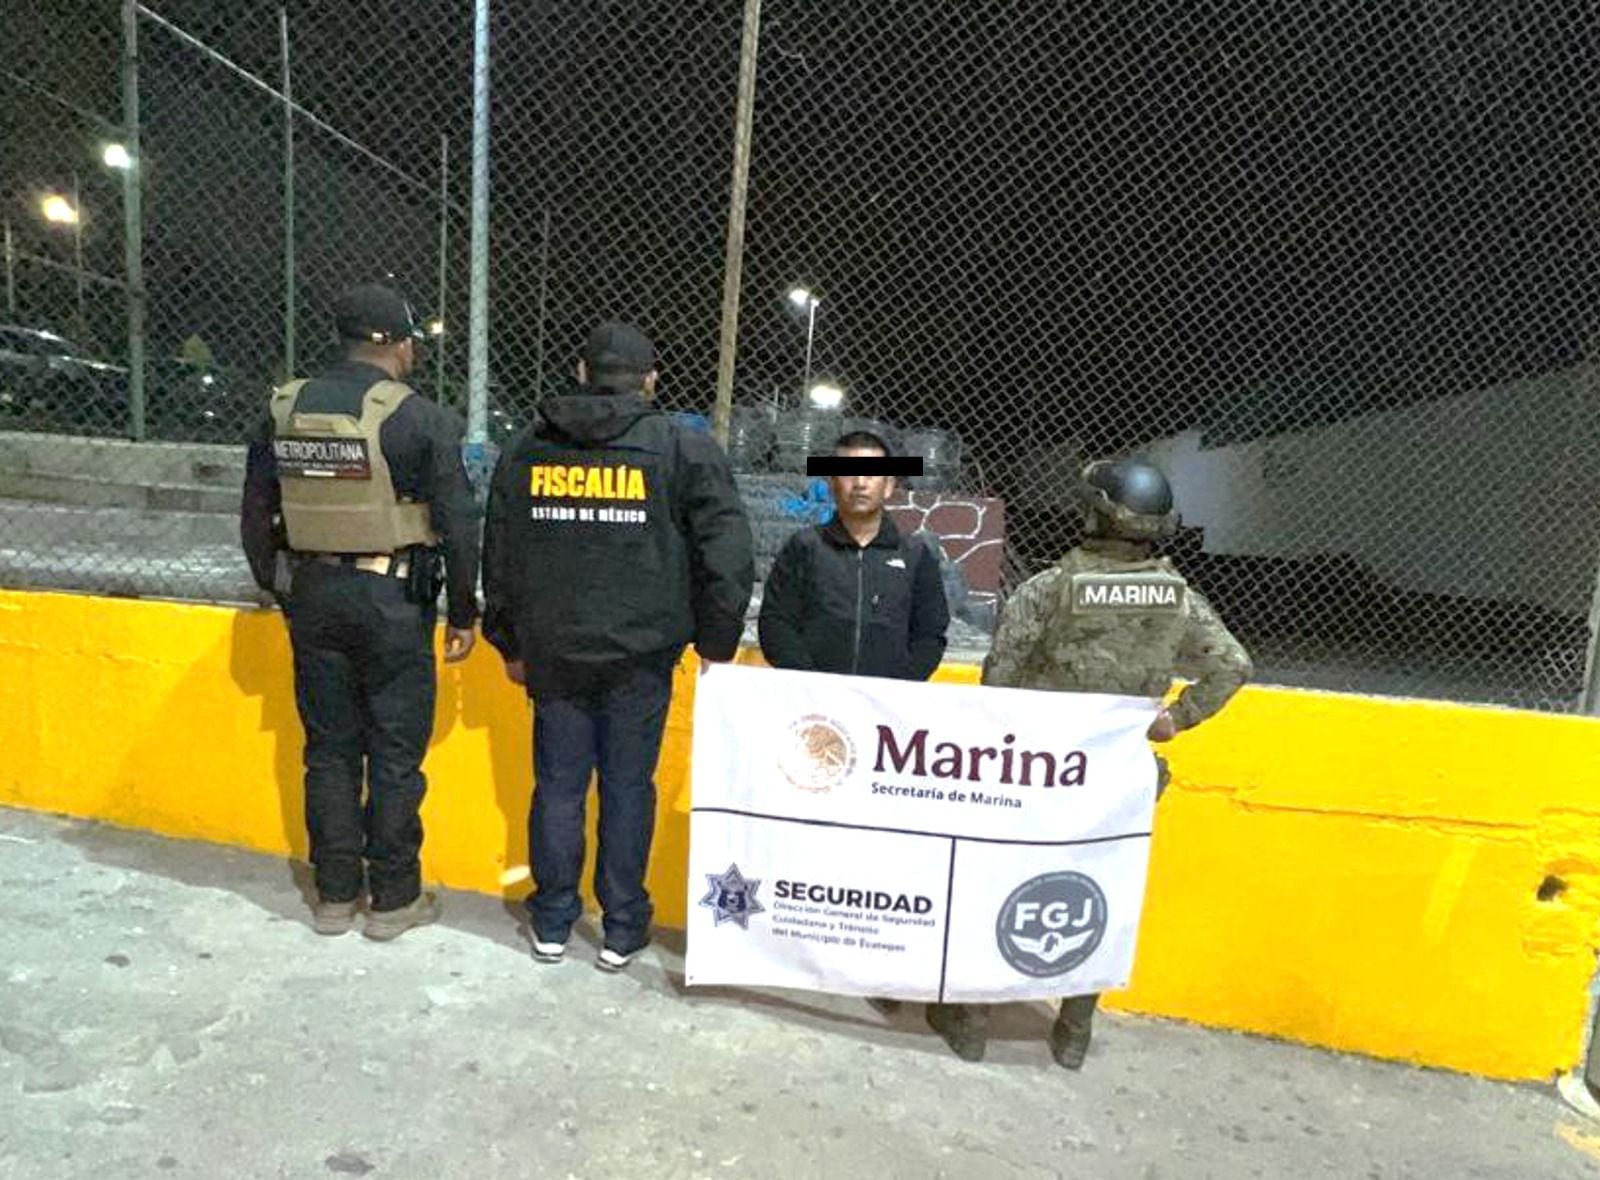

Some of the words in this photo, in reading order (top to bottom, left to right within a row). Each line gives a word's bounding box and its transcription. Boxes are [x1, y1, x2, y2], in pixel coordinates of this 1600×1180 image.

[530, 464, 646, 500] FISCALÍA
[531, 506, 576, 521] ESTADO
[578, 508, 595, 521] DE
[598, 507, 647, 523] MÉXICO
[1084, 585, 1177, 605] MARINA
[873, 724, 1088, 788] Marina
[871, 781, 944, 801] Secretaría
[948, 790, 965, 803] de
[970, 792, 1022, 809] Marina
[774, 879, 933, 914] SEGURIDAD
[823, 906, 863, 919] General
[866, 912, 879, 921] de
[882, 914, 936, 928] Seguridad
[829, 922, 836, 931] y
[1014, 898, 1092, 930] FGJ
[772, 927, 789, 938] del
[843, 937, 856, 946] de
